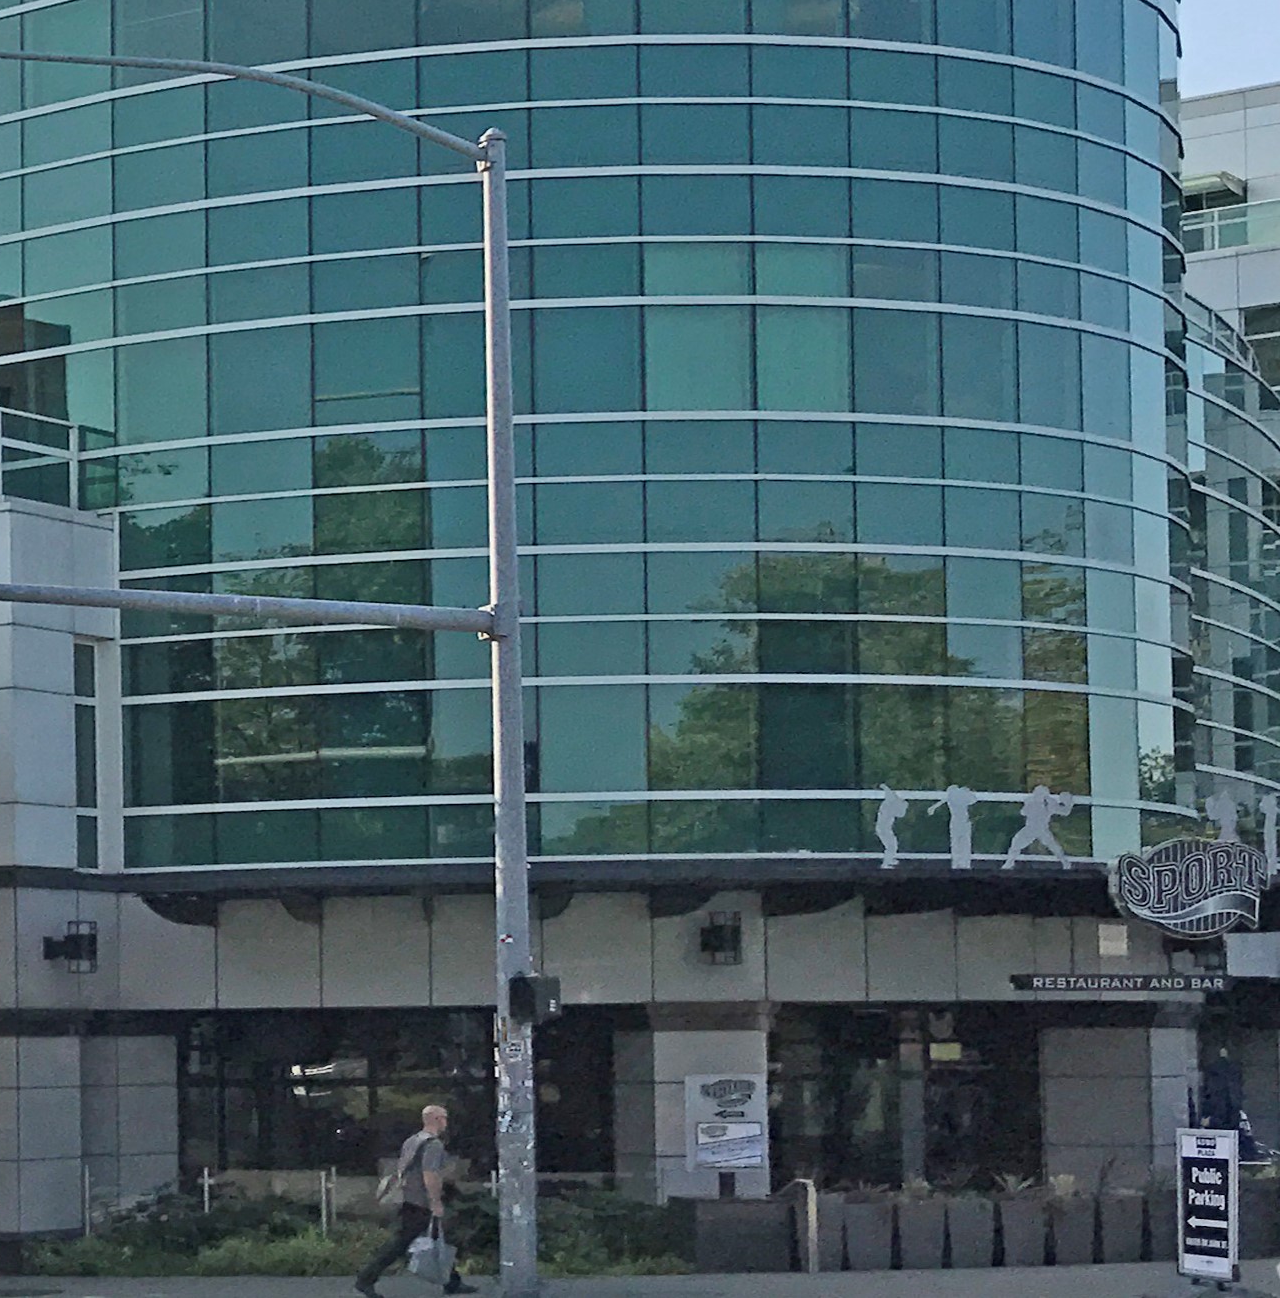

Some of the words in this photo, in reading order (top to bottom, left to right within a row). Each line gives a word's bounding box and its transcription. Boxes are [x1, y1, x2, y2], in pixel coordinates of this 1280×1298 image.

[1119, 843, 1270, 912] SPORT
[1032, 977, 1143, 990] RESTAURANT
[1149, 977, 1185, 990] AND
[1191, 978, 1225, 990] BAR
[1191, 1167, 1223, 1185] Public
[1188, 1189, 1226, 1210] Parking
